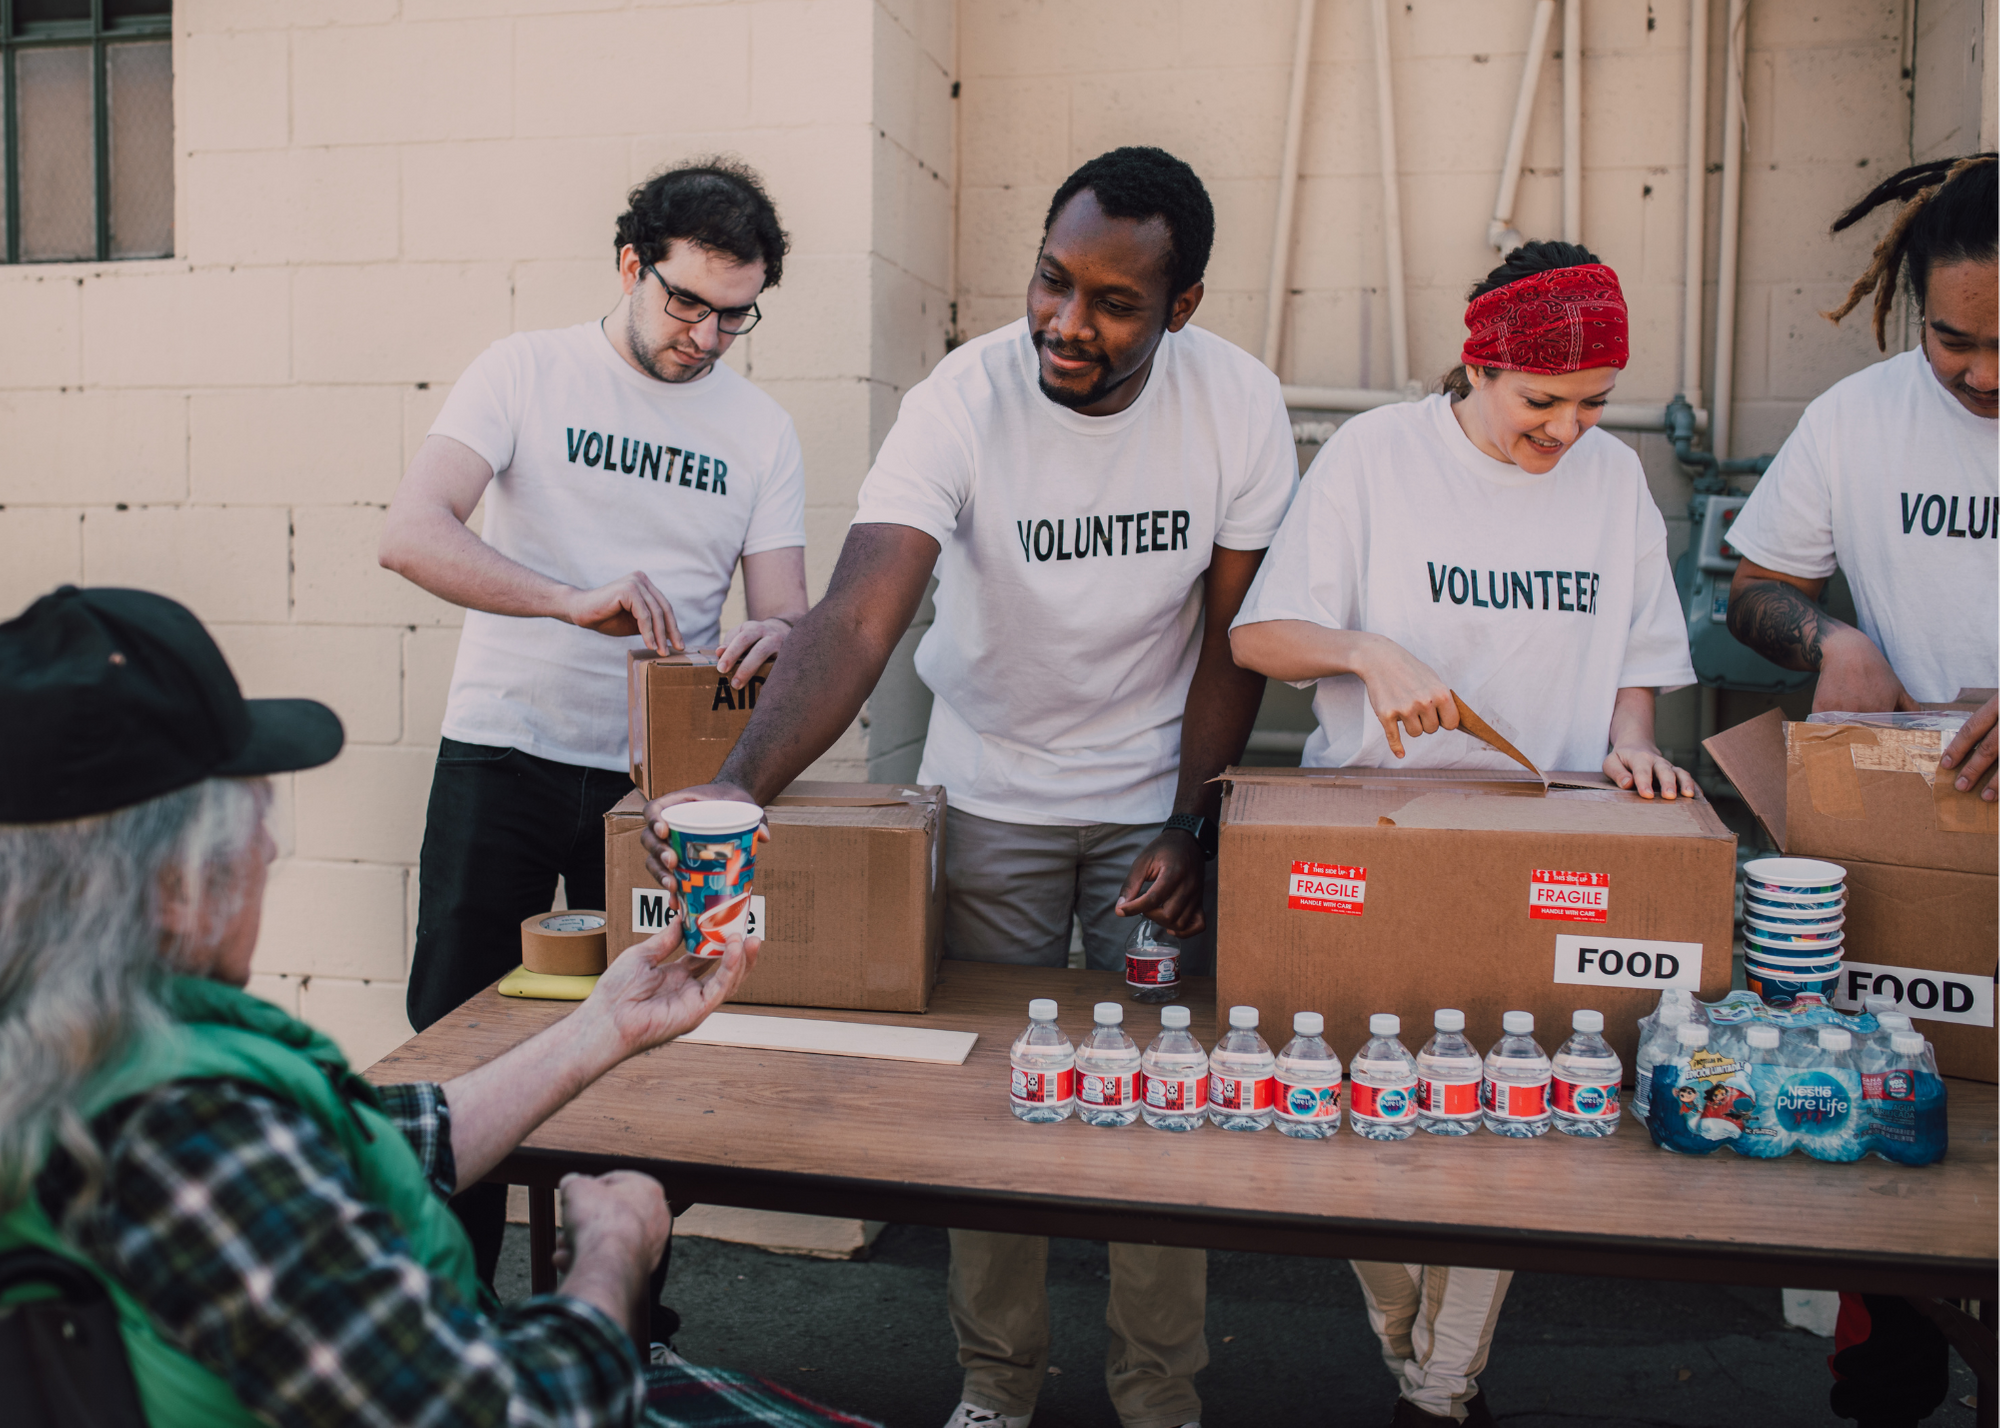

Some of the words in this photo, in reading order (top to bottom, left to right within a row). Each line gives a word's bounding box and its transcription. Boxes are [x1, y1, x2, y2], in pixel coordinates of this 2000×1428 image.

[566, 427, 728, 496] VOLUNTEER
[1017, 510, 1190, 563] VOLUNTEER
[1427, 561, 1600, 616] VOLUNTEER
[1296, 879, 1359, 899] FRAGILE
[1537, 888, 1602, 906] FRAGILE
[1300, 899, 1322, 907] HANDLE
[1577, 948, 1680, 980] FOOD
[1848, 970, 1975, 1013] FOOD
[1777, 1096, 1816, 1110] Pure
[1819, 1098, 1848, 1118] Life
[1893, 1104, 1916, 1112] AGUA
